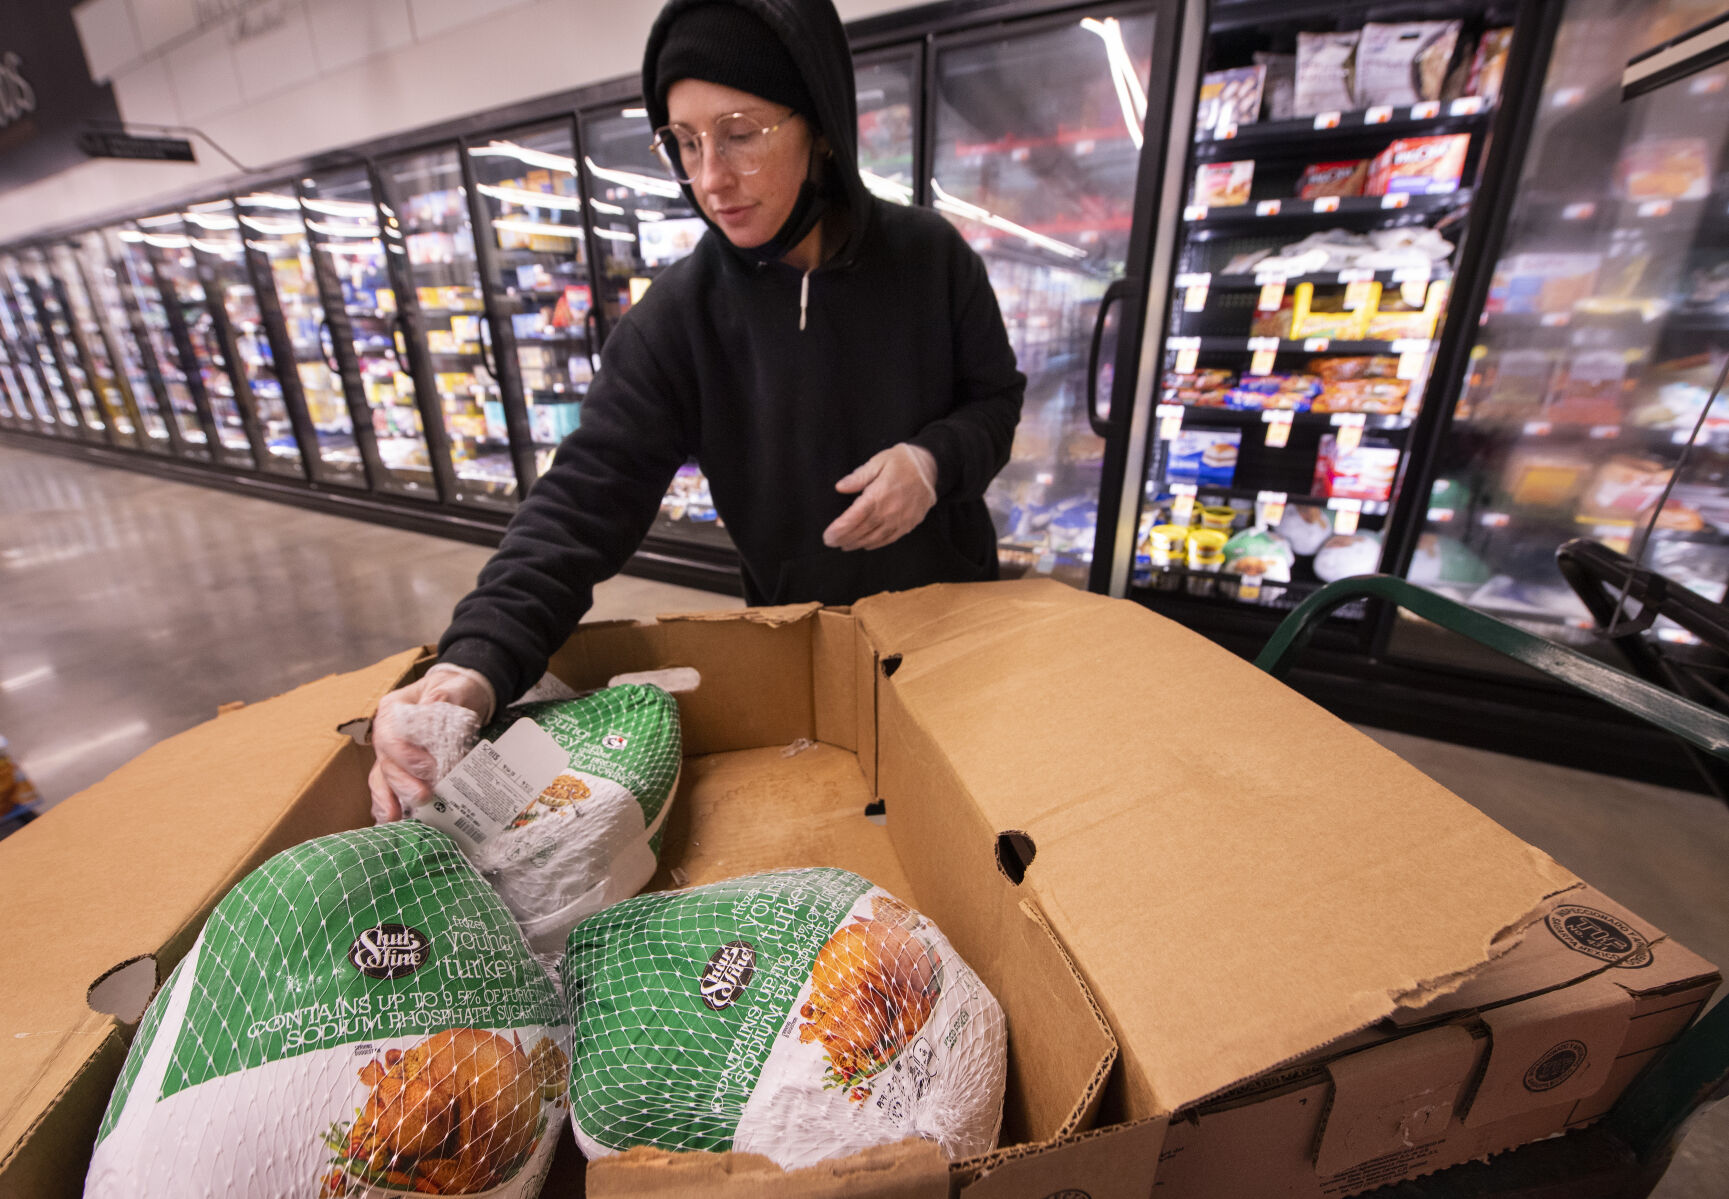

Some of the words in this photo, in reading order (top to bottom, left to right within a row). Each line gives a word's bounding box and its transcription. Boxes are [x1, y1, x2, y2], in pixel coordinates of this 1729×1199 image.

[445, 931, 515, 958] young
[443, 954, 518, 988] turkey
[247, 995, 373, 1040] CONTAINS
[377, 993, 407, 1012] UP
[413, 991, 440, 1009] TO
[443, 990, 482, 1008] 9.5%
[483, 988, 502, 1005] OF
[285, 1015, 384, 1050] SODIUM
[711, 1006, 763, 1113] CONTAINS
[755, 976, 779, 1004] UP
[770, 954, 793, 978] TO
[735, 1001, 783, 1085] SODIUM
